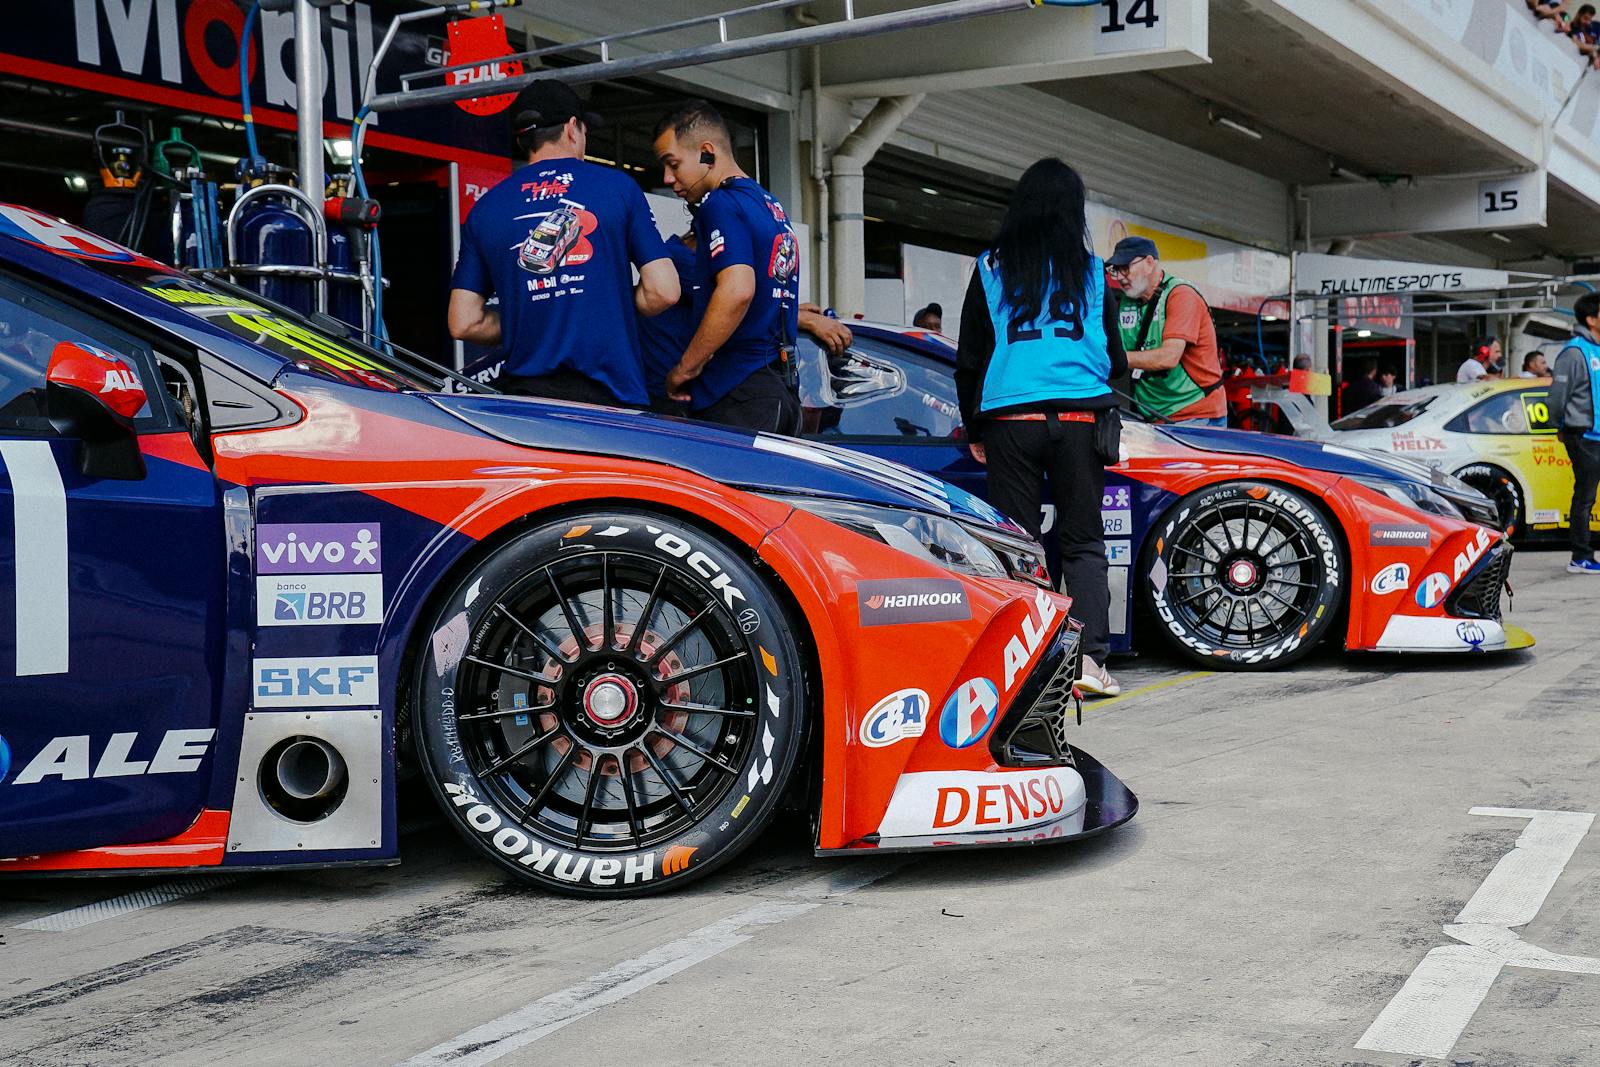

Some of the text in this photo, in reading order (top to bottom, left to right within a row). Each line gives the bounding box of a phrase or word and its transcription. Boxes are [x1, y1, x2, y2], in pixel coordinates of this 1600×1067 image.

[1100, 0, 1159, 32] 14
[74, 0, 379, 125] Mobil
[1484, 190, 1518, 212] 15
[527, 276, 557, 291] Mobil
[922, 394, 958, 417] Mobil
[1527, 403, 1549, 423] 10
[1392, 438, 1447, 451] HELIX
[1104, 519, 1123, 532] RB
[261, 533, 345, 564] vivo
[1454, 527, 1490, 583] ALE
[276, 582, 307, 591] banco
[307, 592, 366, 620] BRB
[1004, 587, 1056, 691] ALE
[1457, 621, 1484, 643] Fini
[258, 666, 374, 697] SKF
[12, 728, 216, 784] ALE
[933, 775, 1064, 829] DENSO
